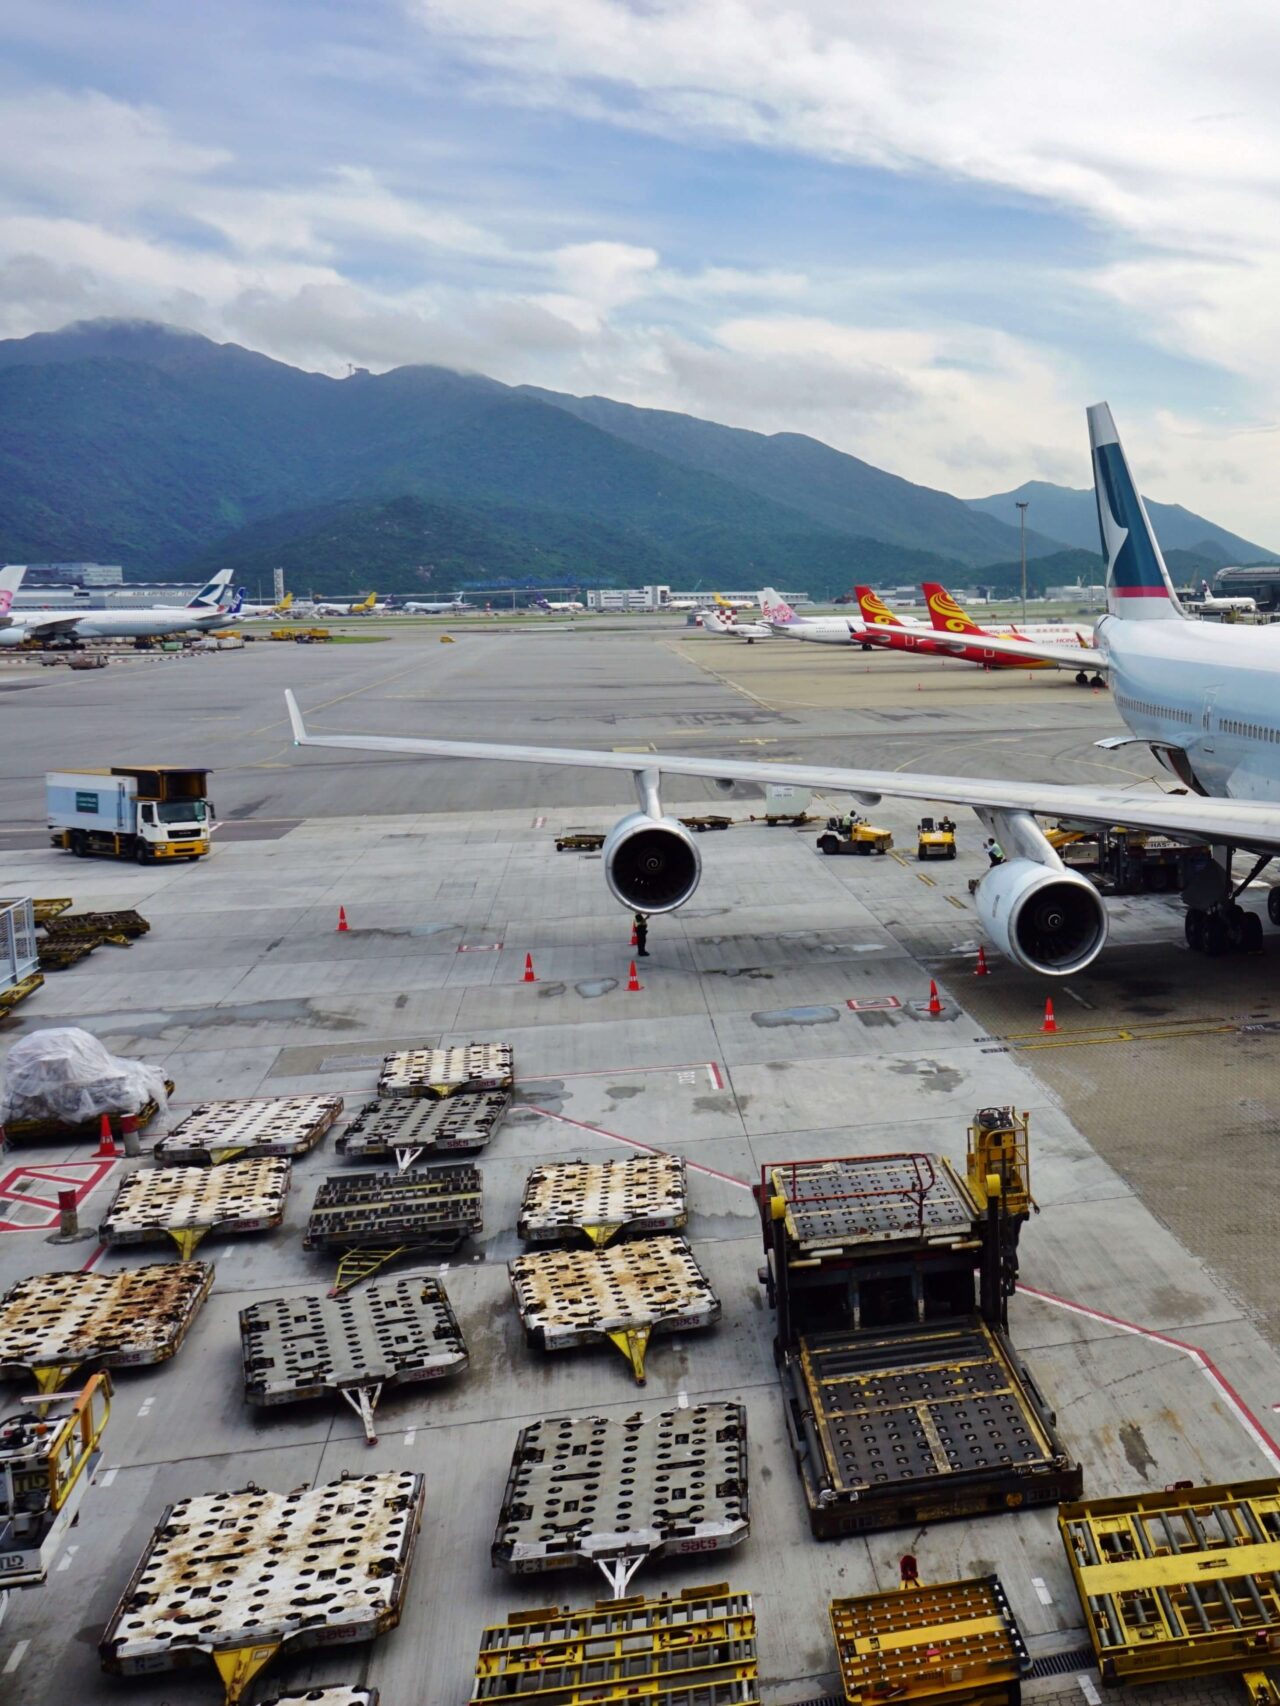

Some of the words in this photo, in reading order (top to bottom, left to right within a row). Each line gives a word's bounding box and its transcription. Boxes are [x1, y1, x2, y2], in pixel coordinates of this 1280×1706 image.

[640, 1219, 666, 1228] sats
[413, 1366, 444, 1380] sats
[680, 1538, 718, 1551] sats
[315, 1627, 357, 1641] sats
